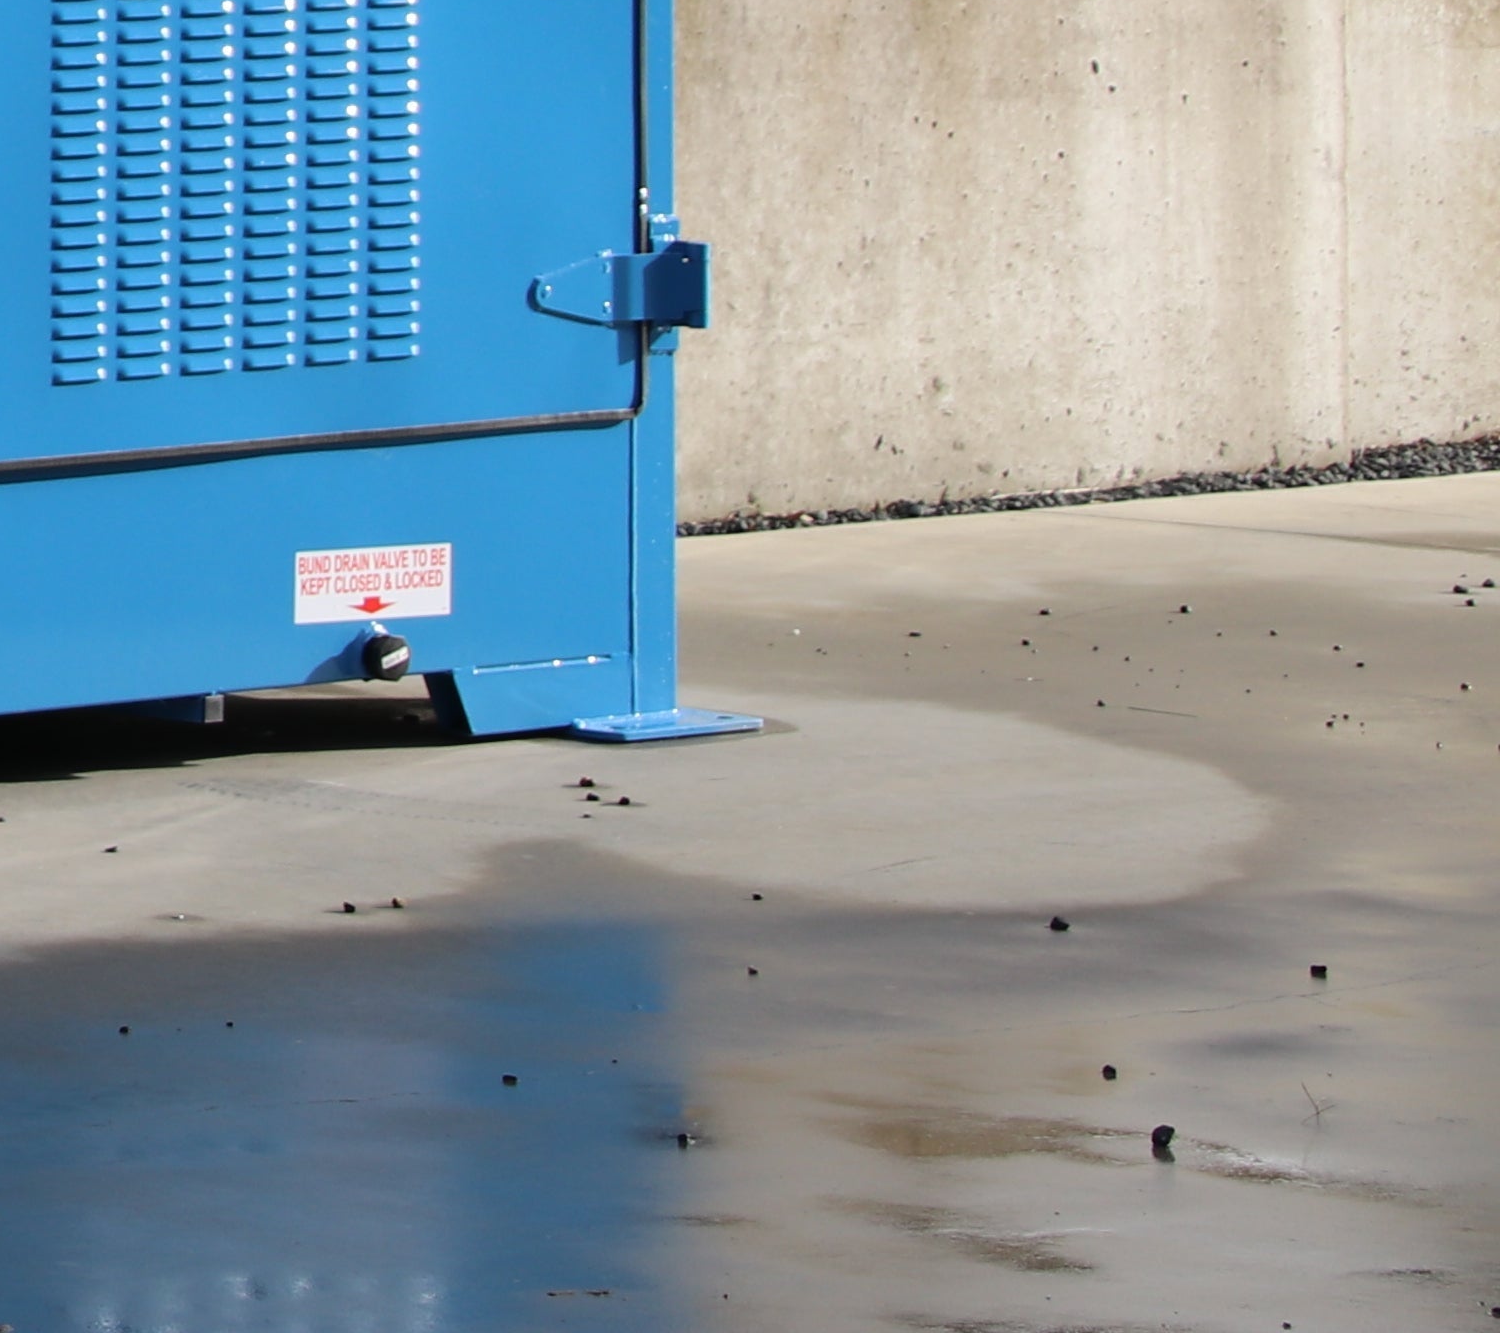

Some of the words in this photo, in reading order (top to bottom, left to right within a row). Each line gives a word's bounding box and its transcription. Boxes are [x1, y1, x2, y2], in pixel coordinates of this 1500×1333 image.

[298, 556, 331, 575] BUND
[334, 552, 371, 573] DRAIN
[372, 549, 409, 570] VALVE
[411, 548, 428, 567] TO
[430, 547, 447, 566] BE
[300, 575, 332, 596] KEPT
[334, 573, 382, 594] CLOSED
[384, 572, 392, 590] &
[395, 569, 444, 590] LOCKED
